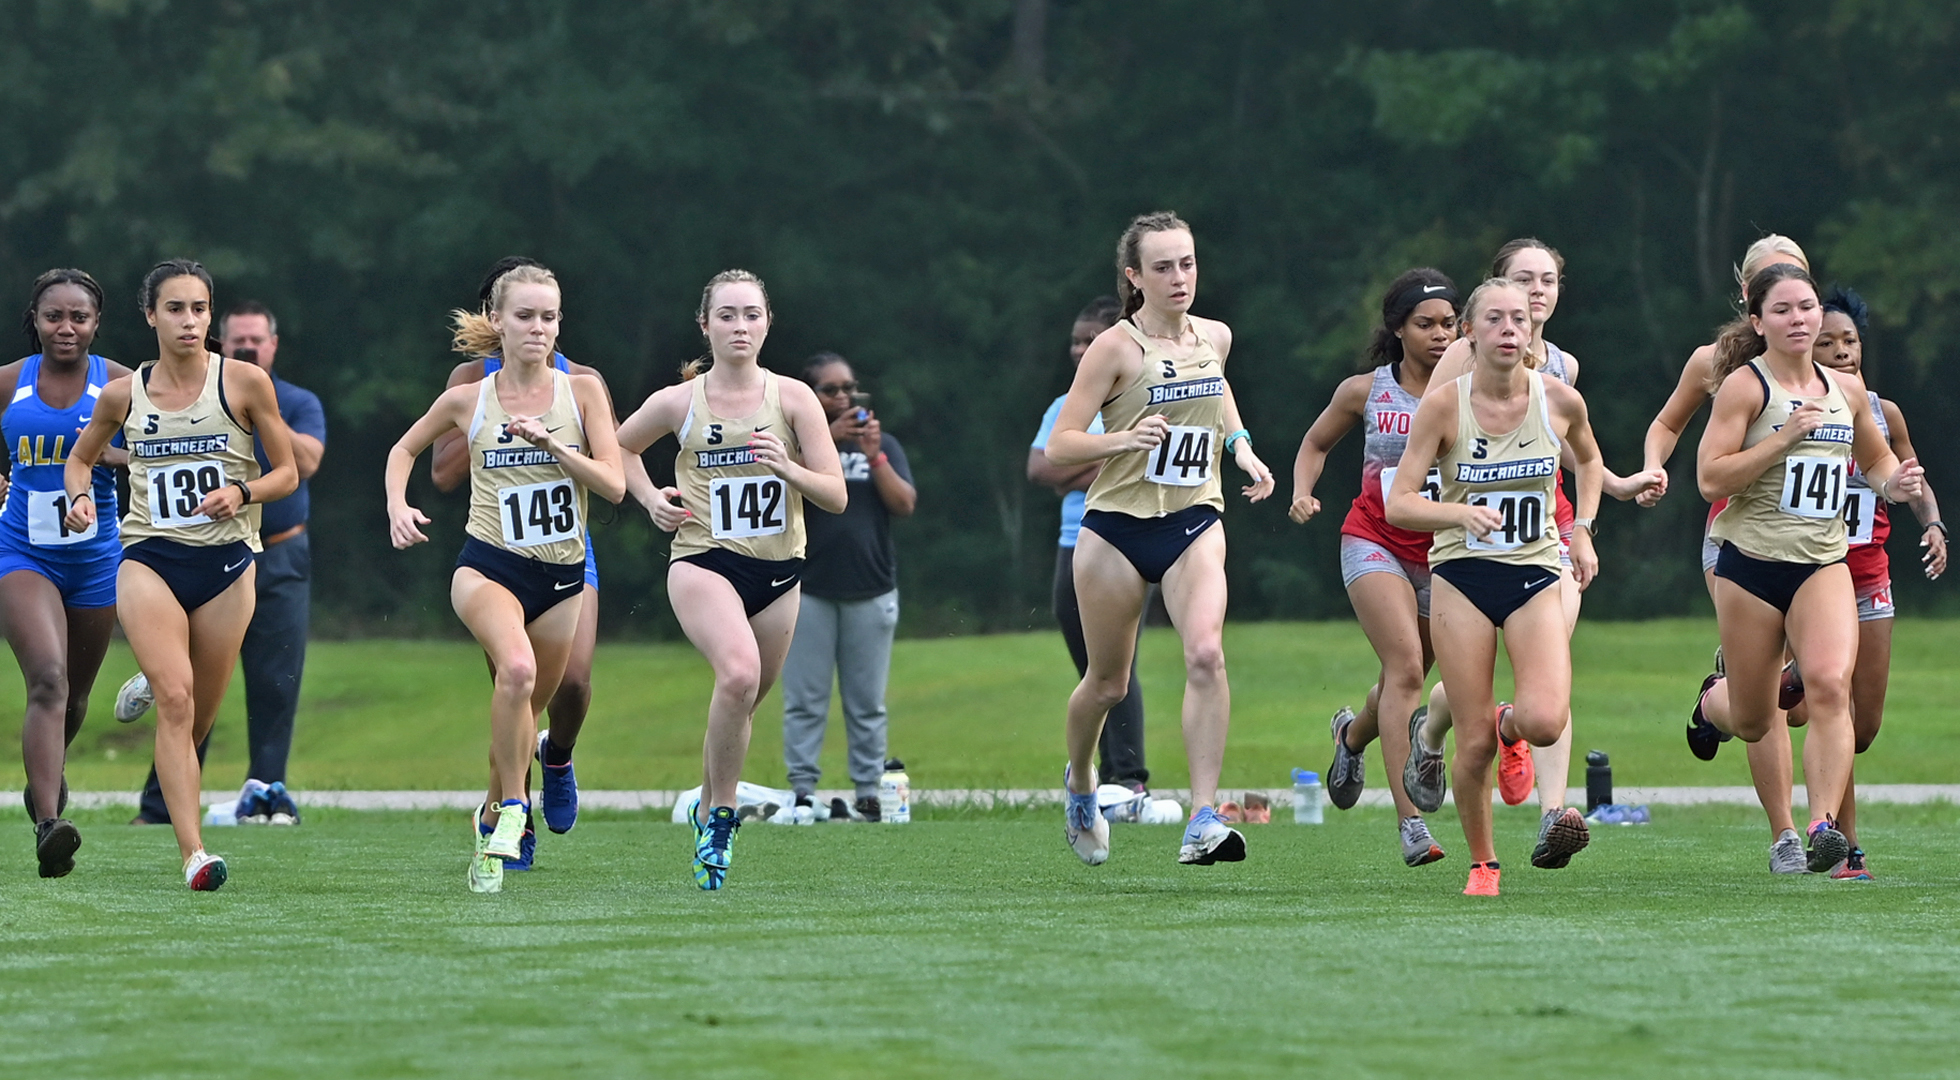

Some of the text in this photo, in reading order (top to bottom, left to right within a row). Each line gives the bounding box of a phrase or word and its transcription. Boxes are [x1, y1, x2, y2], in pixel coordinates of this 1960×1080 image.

[1150, 380, 1225, 404] BUCCANEERS
[1376, 411, 1415, 435] WO
[1778, 426, 1854, 444] CANEERS
[18, 435, 69, 466] ALL
[136, 436, 227, 457] BUCCANEERS
[485, 449, 577, 468] BUCCANE
[698, 450, 768, 467] BUCCAN
[1154, 431, 1210, 478] 144
[1458, 459, 1554, 482] BUCCANEERS
[152, 465, 222, 519] 139
[1790, 462, 1842, 511] 141
[52, 495, 70, 538] 1
[504, 484, 576, 541] 143
[715, 480, 783, 531] 142
[1845, 494, 1861, 537] 4
